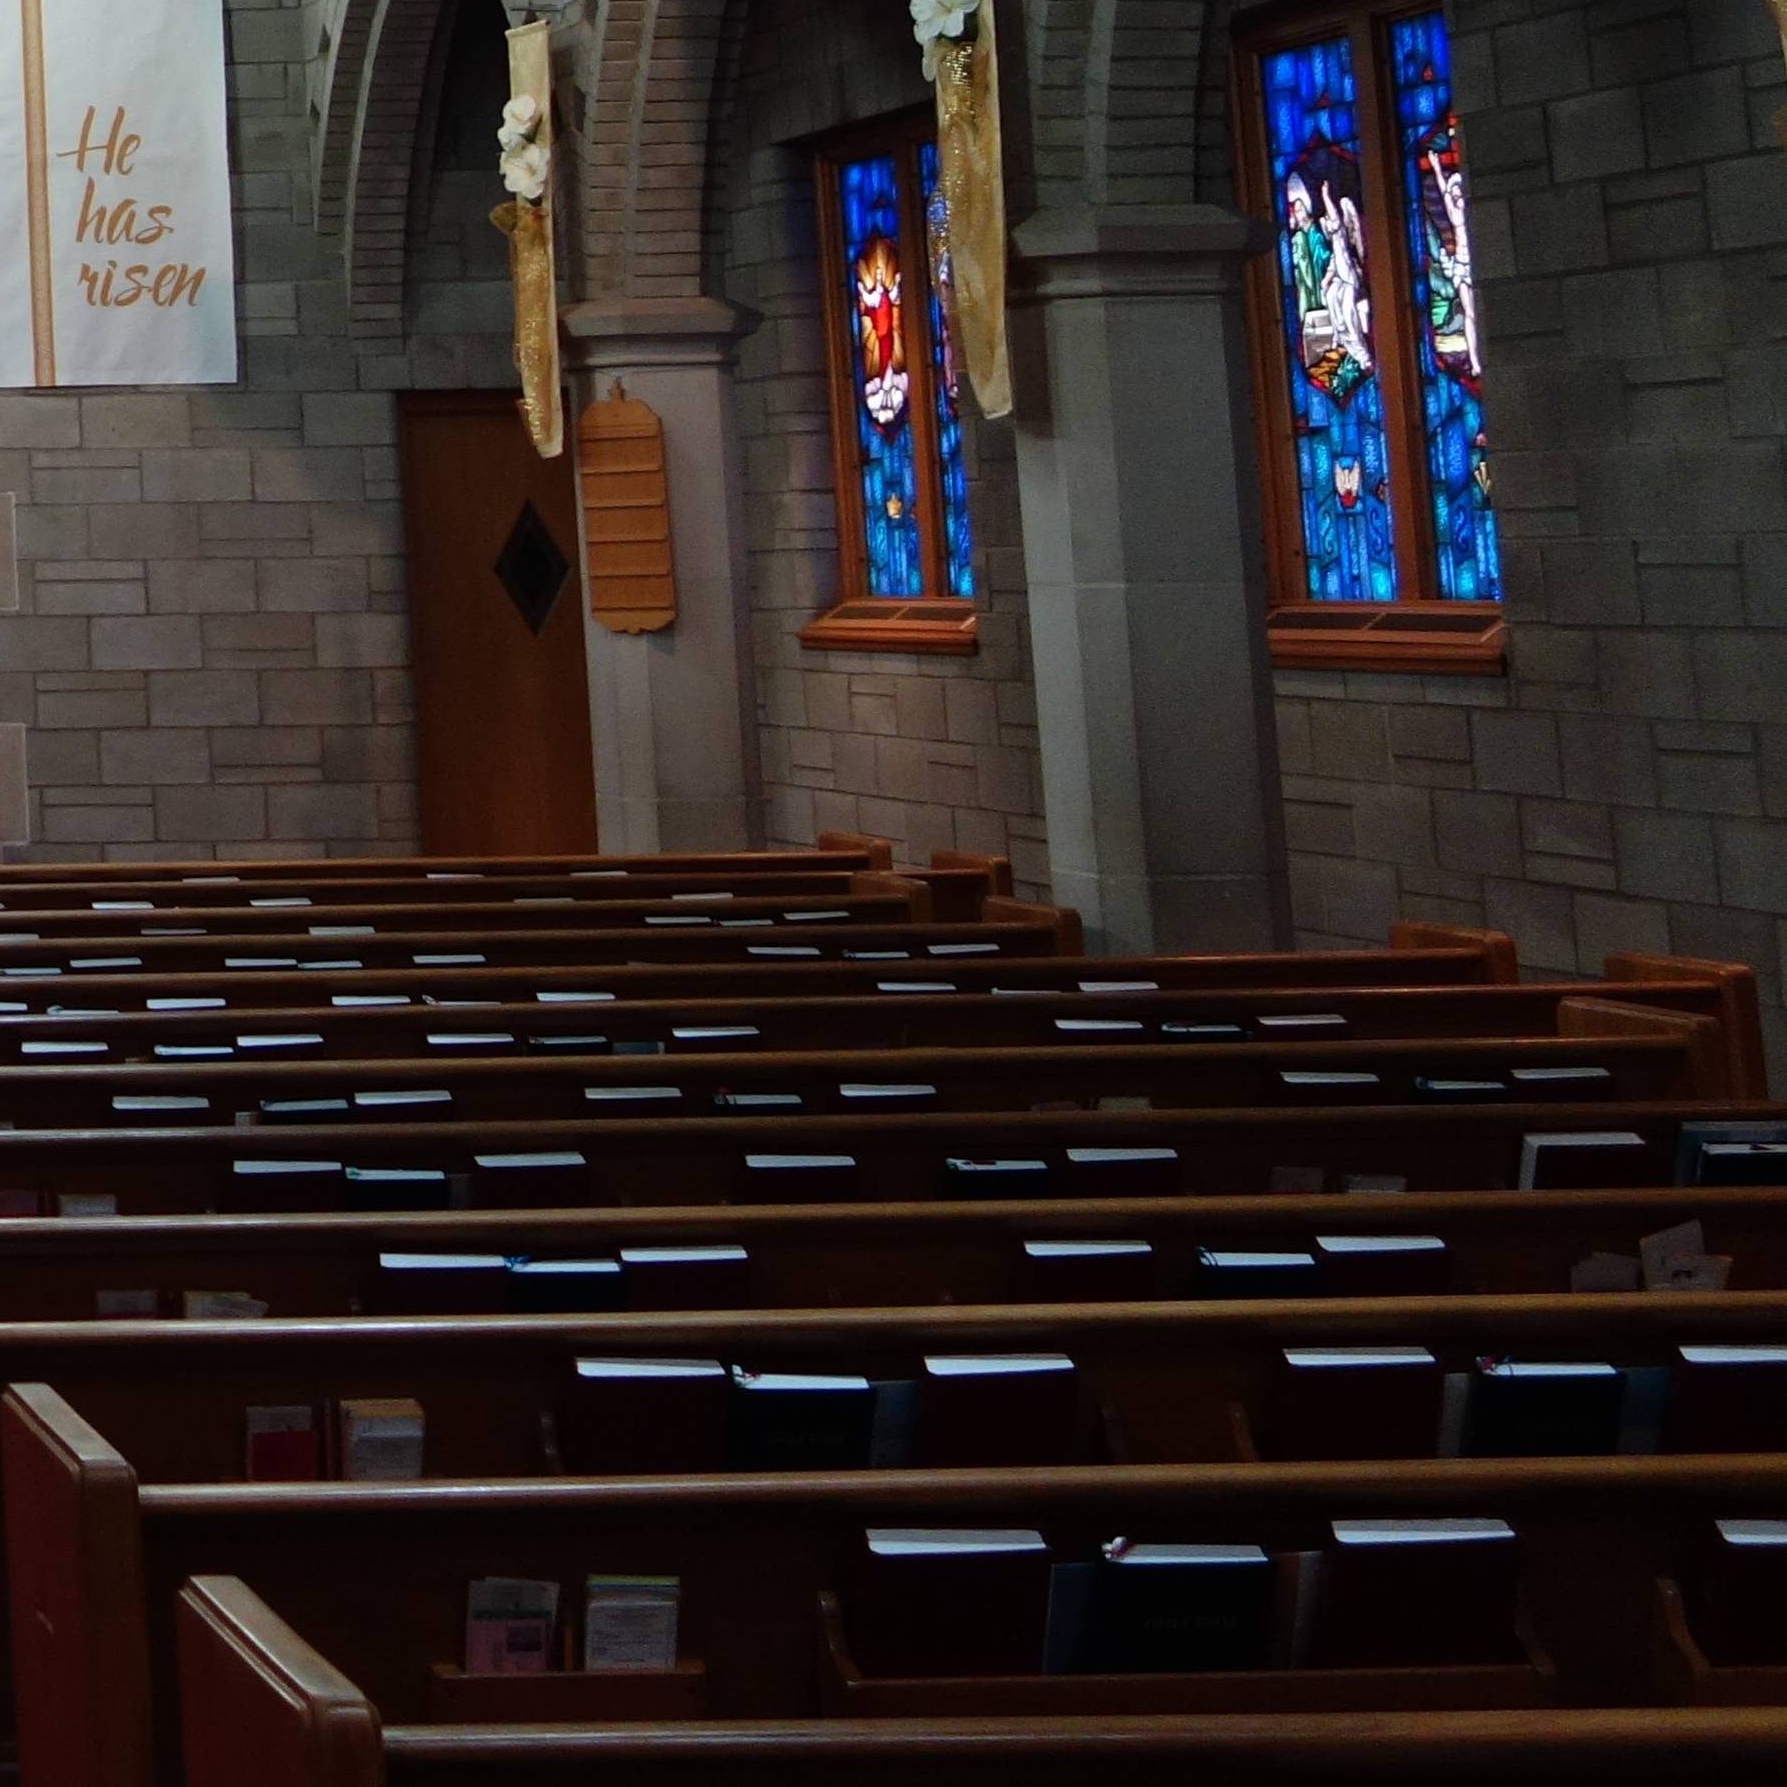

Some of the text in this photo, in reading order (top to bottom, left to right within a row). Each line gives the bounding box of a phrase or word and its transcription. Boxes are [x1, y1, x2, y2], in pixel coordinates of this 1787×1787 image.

[57, 107, 141, 175] He
[76, 178, 173, 244] has
[78, 261, 206, 307] risen
